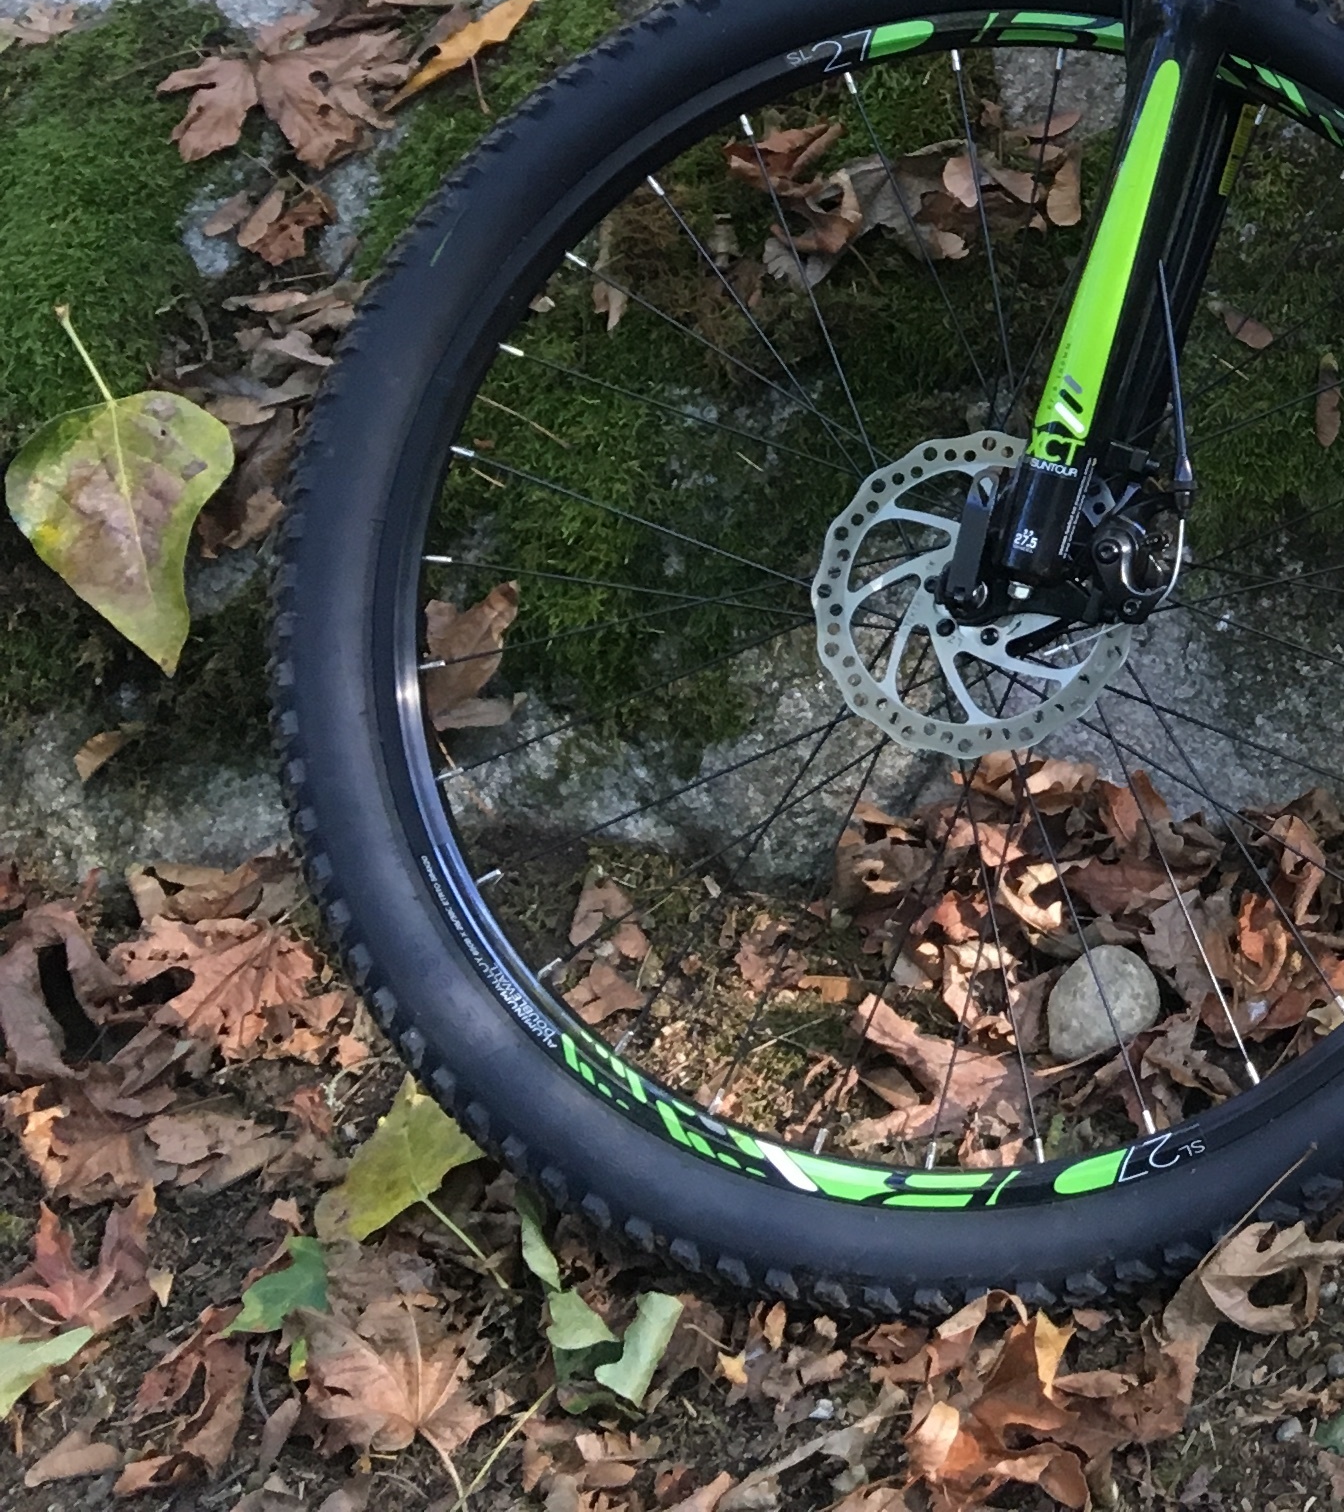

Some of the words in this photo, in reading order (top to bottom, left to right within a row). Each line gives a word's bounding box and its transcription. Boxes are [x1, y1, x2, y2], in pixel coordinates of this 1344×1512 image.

[786, 49, 813, 67] SL
[811, 29, 872, 73] 27
[1026, 428, 1086, 466] XCT
[1030, 458, 1079, 478] SUNTOUR
[1118, 1132, 1181, 1182] 27
[1178, 1139, 1206, 1157] SL
